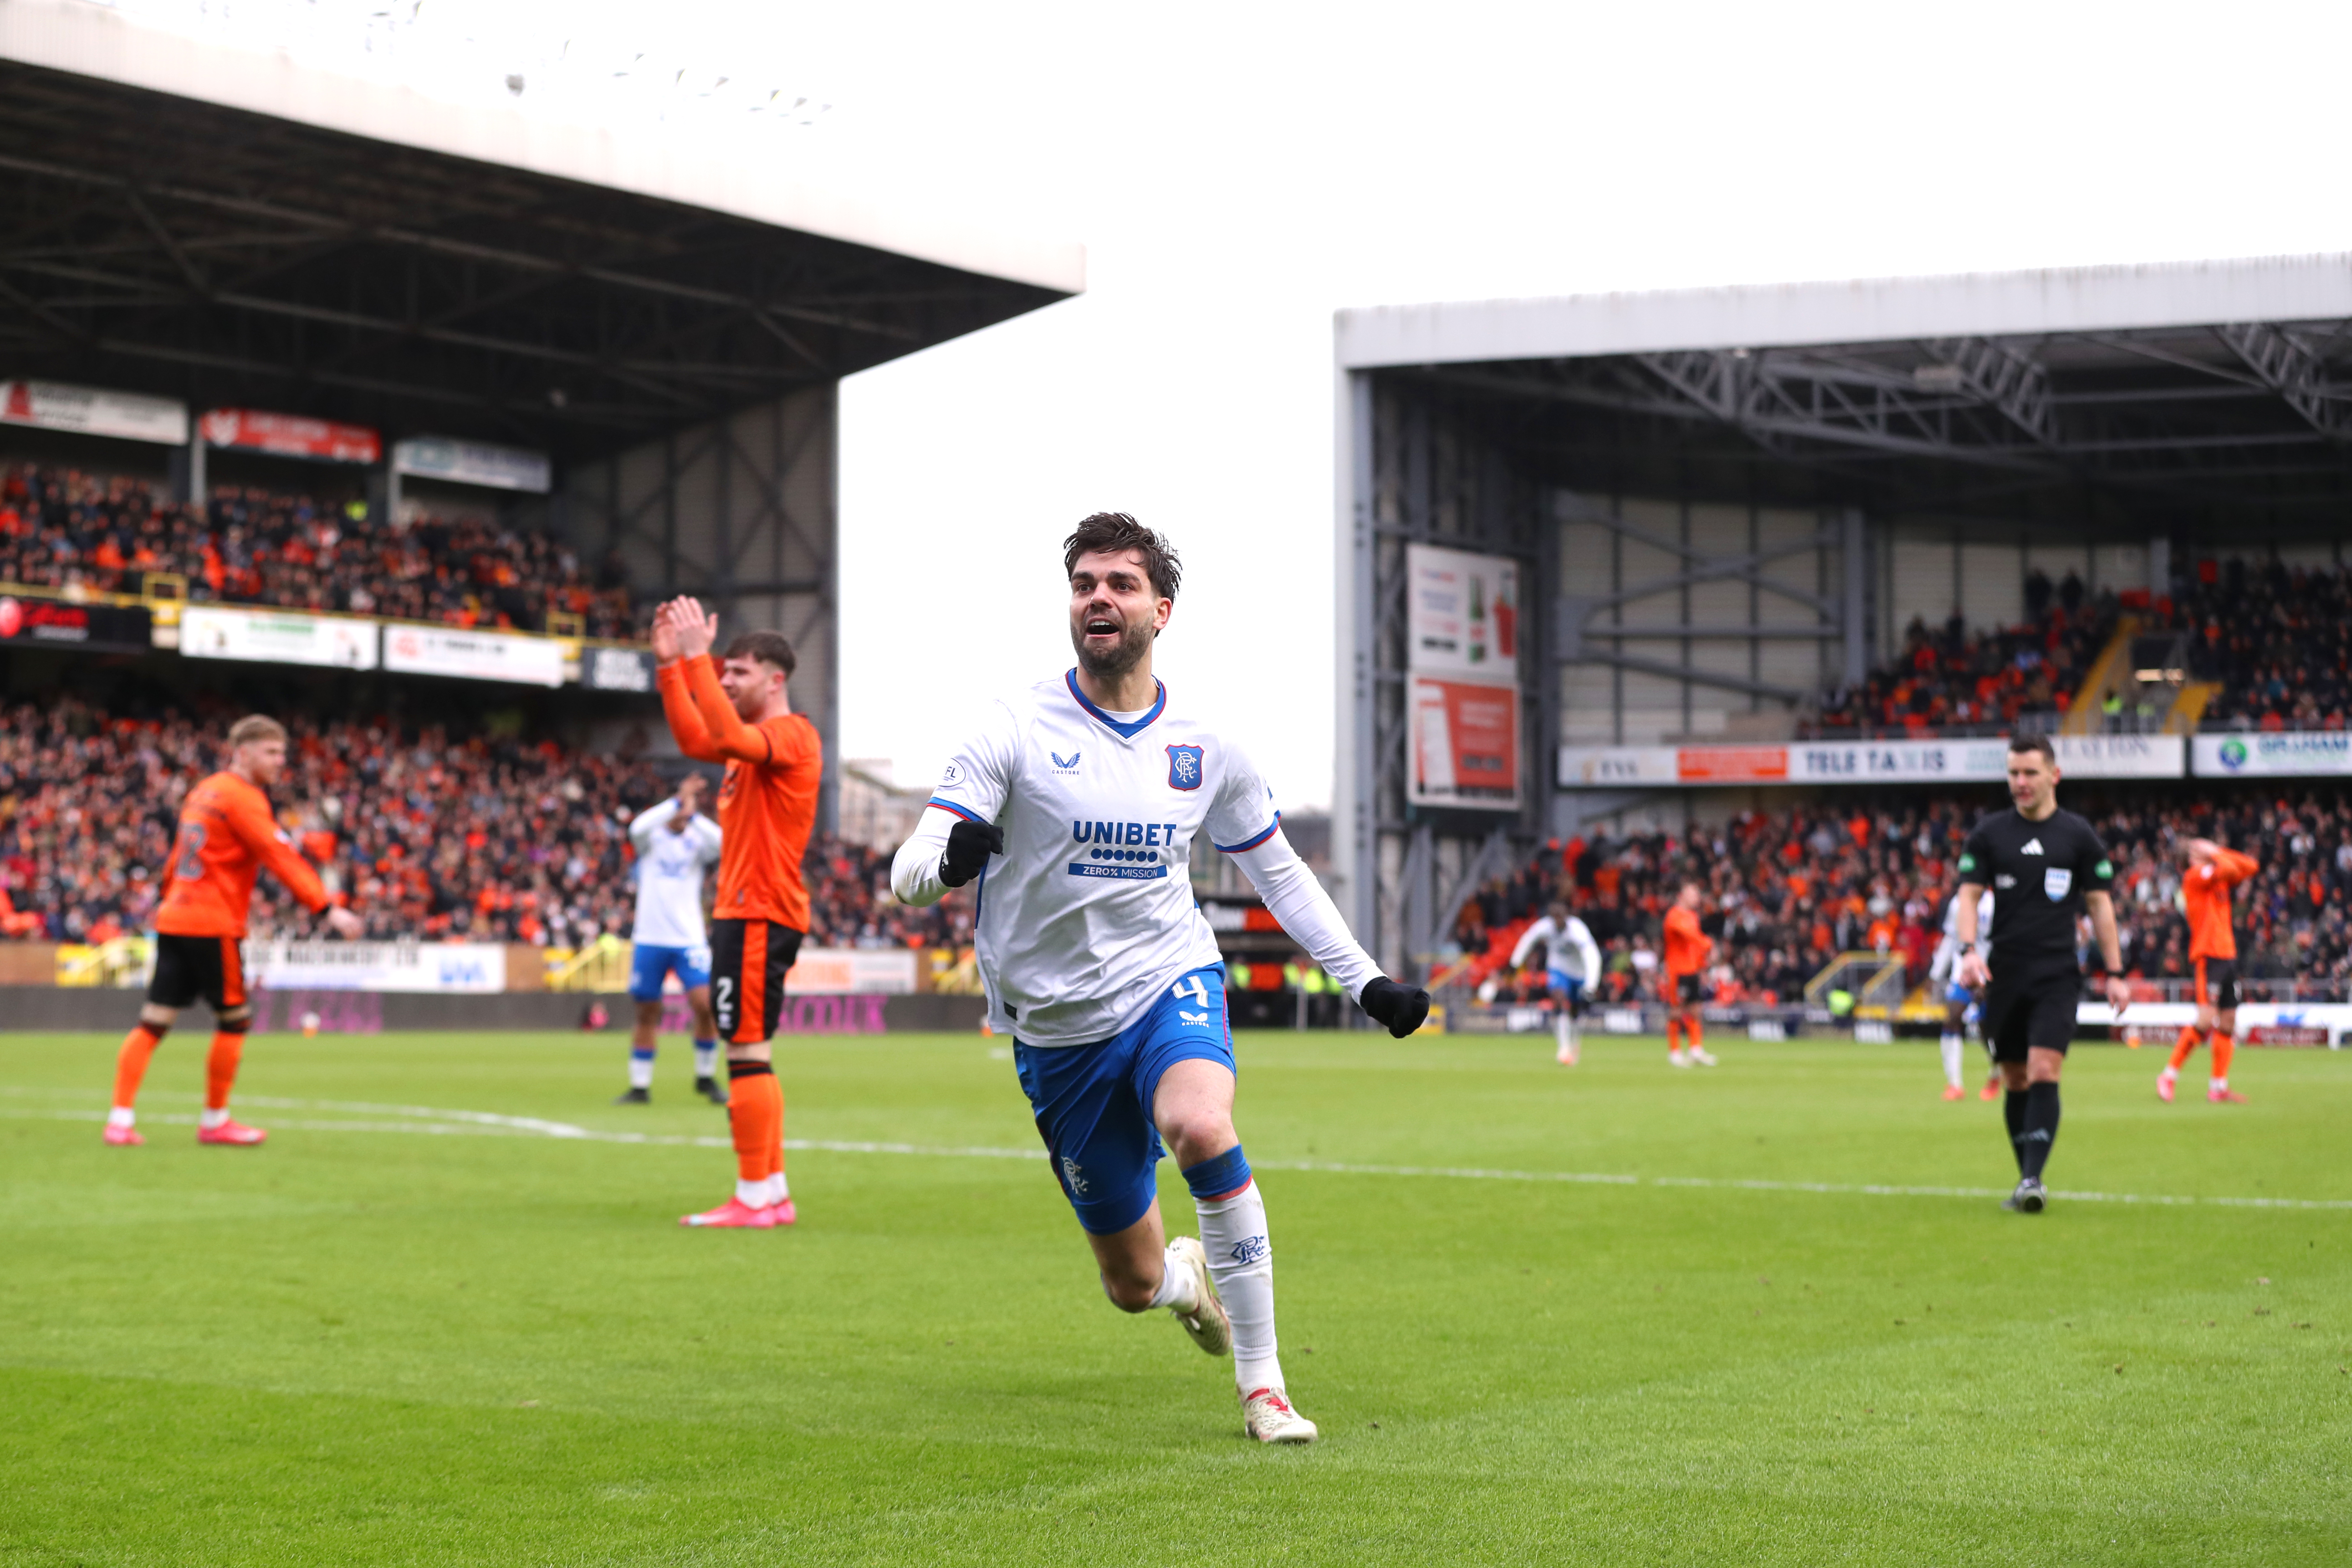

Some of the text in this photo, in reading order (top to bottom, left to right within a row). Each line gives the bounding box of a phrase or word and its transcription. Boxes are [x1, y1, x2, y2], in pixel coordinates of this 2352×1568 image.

[943, 766, 956, 778] FL
[1073, 820, 1177, 846] UNIBET
[1083, 866, 1158, 878] ZERO% MISSION
[716, 976, 733, 1011] 2
[1171, 975, 1209, 1008] 4
